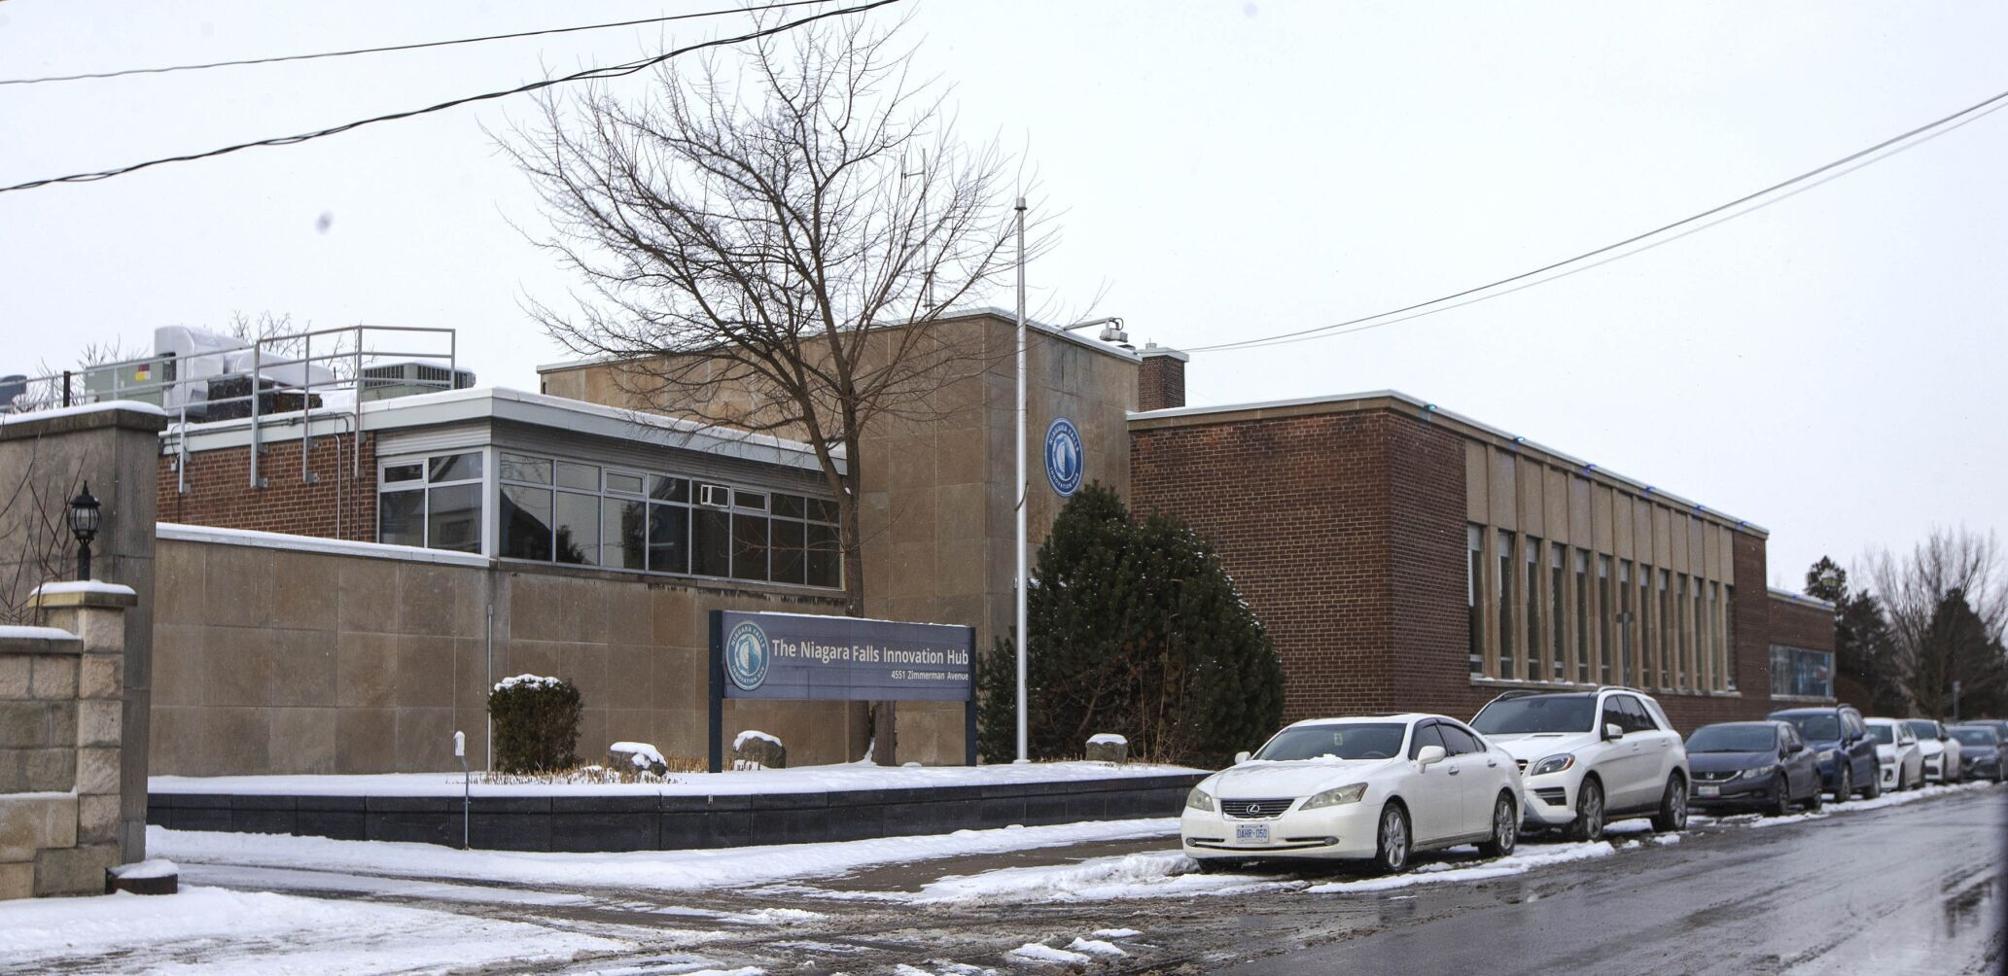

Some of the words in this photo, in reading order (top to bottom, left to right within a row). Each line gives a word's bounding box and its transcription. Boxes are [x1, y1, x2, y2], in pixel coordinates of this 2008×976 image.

[730, 625, 752, 648] NIAGARA
[752, 626, 765, 648] FALLS
[772, 638, 797, 657] The
[800, 641, 850, 664] Niagara
[852, 645, 880, 662] Falls
[883, 647, 944, 664] Innovation
[947, 649, 969, 665] Hub
[891, 670, 906, 680] 4551
[907, 670, 945, 681] Zimmerman
[947, 671, 969, 681] Avenue
